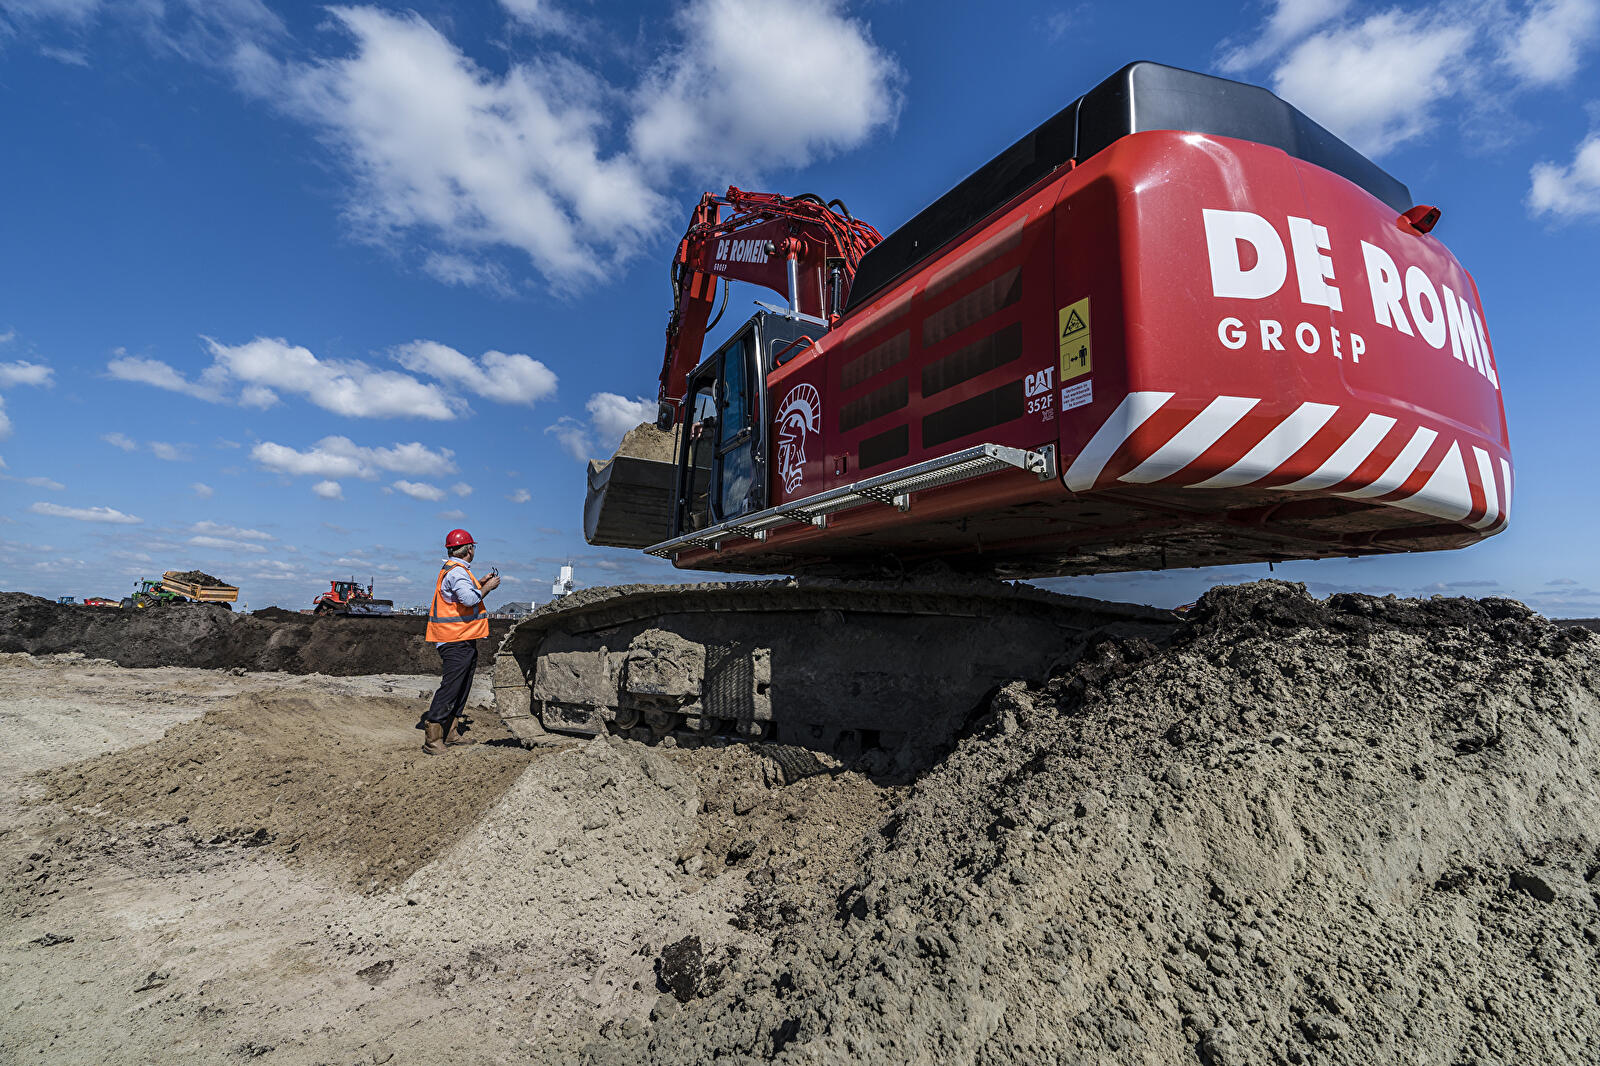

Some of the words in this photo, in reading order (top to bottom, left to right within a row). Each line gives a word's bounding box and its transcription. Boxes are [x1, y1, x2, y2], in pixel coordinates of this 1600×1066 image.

[716, 239, 730, 260] DE
[1203, 208, 1342, 312] DE
[1218, 317, 1366, 363] GROEP
[1025, 366, 1054, 397] CAT
[1027, 393, 1053, 414] 352F
